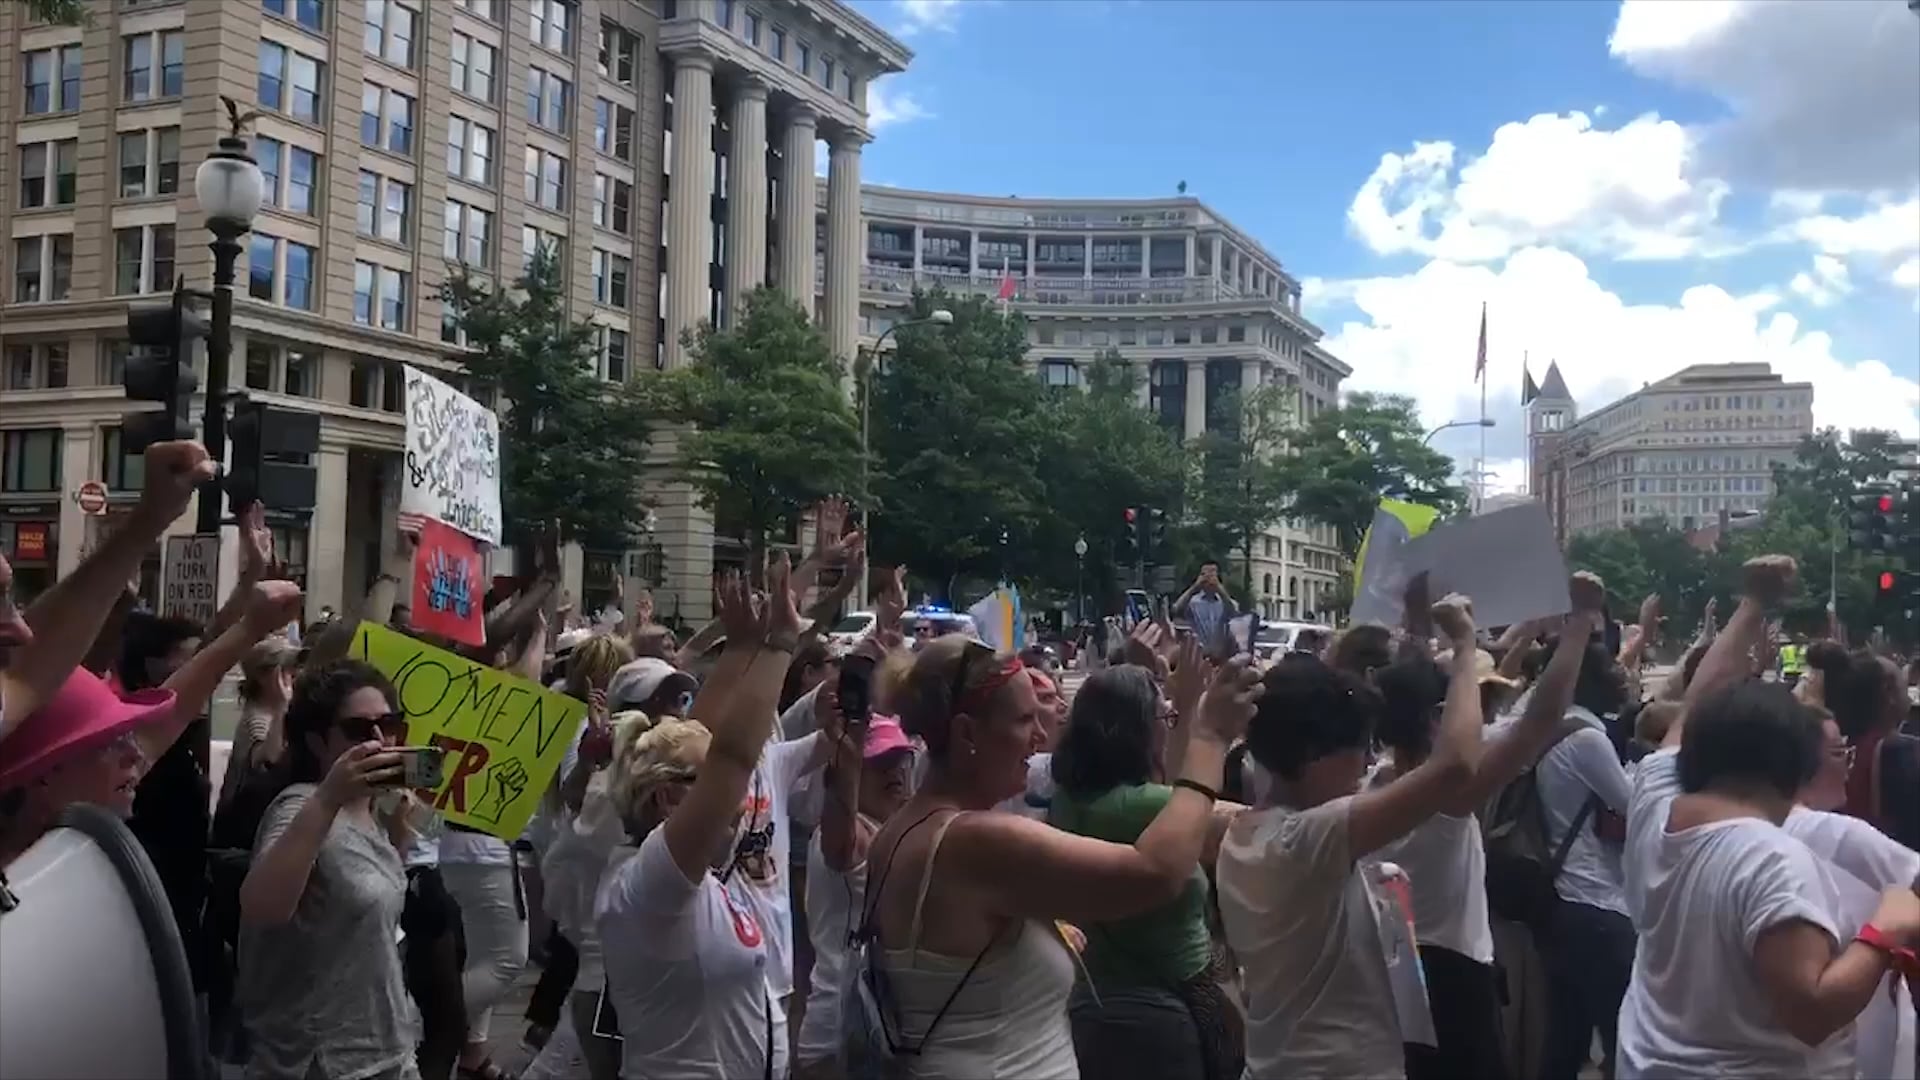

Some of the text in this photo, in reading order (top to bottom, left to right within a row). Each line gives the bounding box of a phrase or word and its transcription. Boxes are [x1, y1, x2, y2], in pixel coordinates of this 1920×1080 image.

[183, 543, 203, 559] NO
[177, 562, 207, 579] TURN
[168, 583, 213, 599] ON RED
